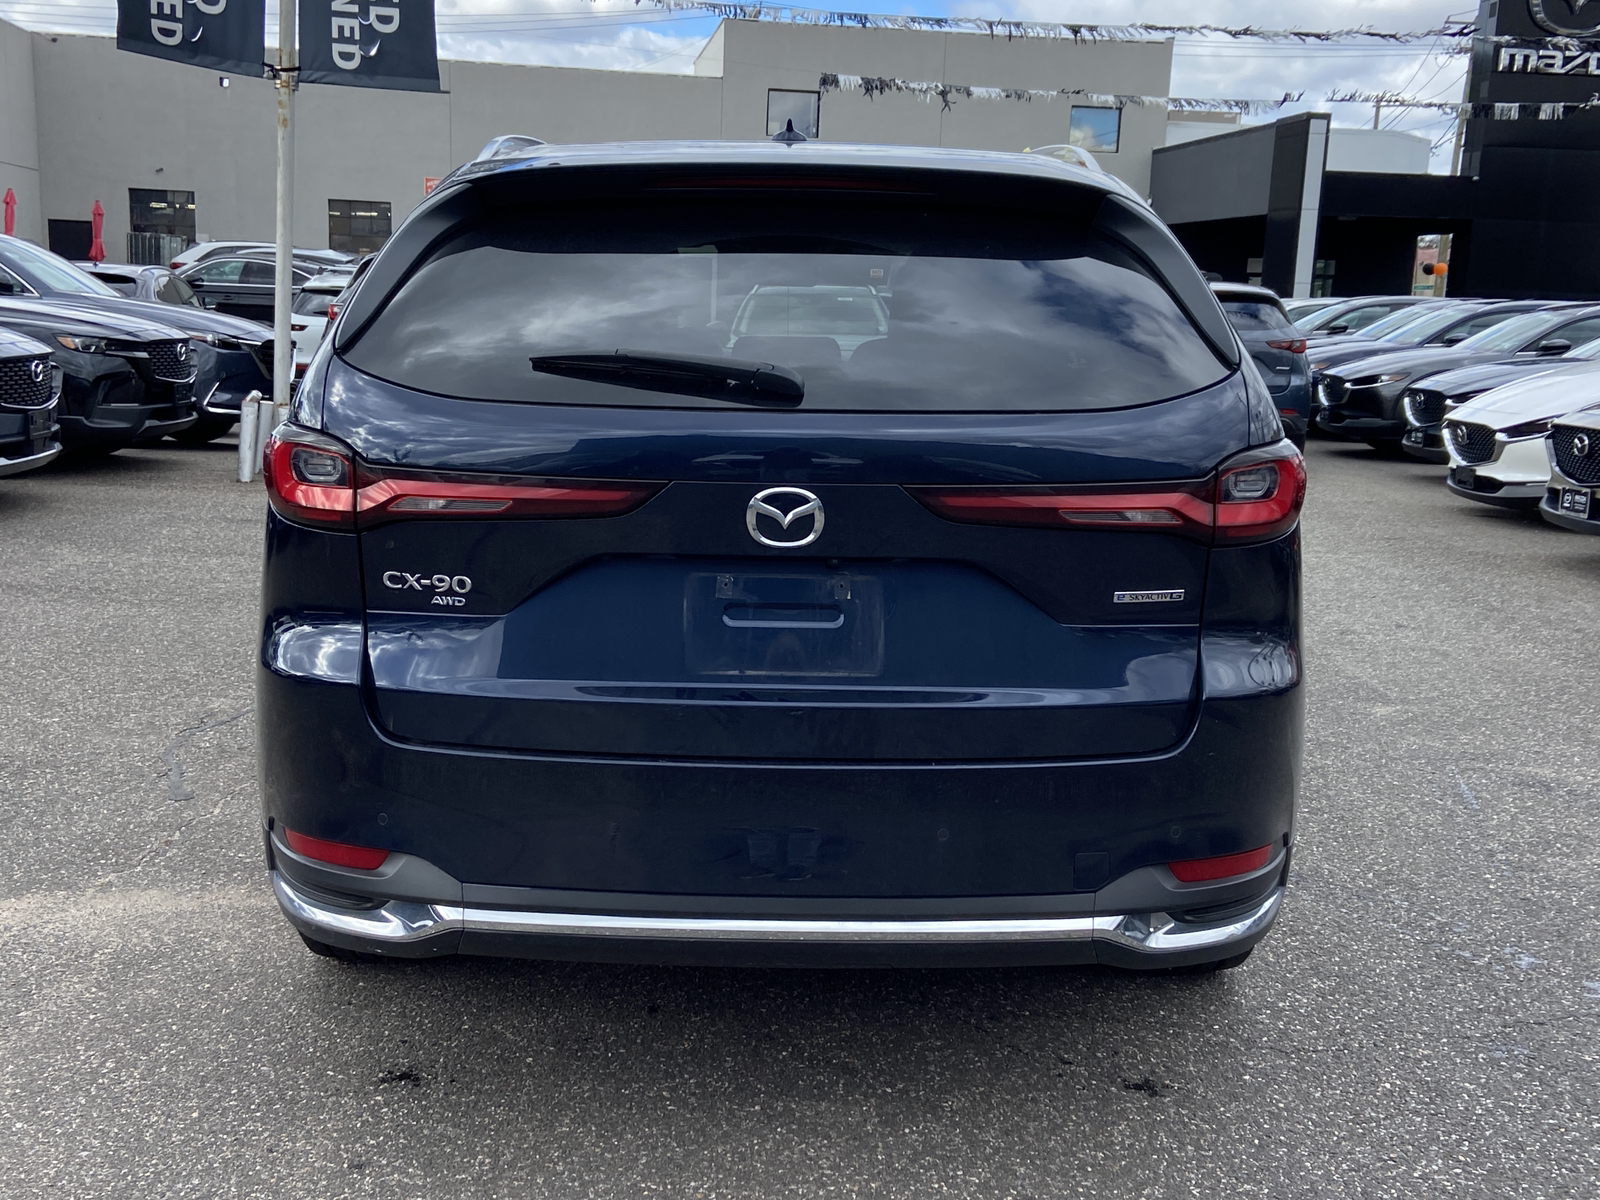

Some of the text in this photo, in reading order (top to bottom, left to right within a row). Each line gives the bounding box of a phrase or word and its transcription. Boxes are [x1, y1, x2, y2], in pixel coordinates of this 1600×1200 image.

[382, 571, 472, 594] CX-90
[430, 595, 466, 606] AWD
[1129, 592, 1169, 601] SKYACTIV
